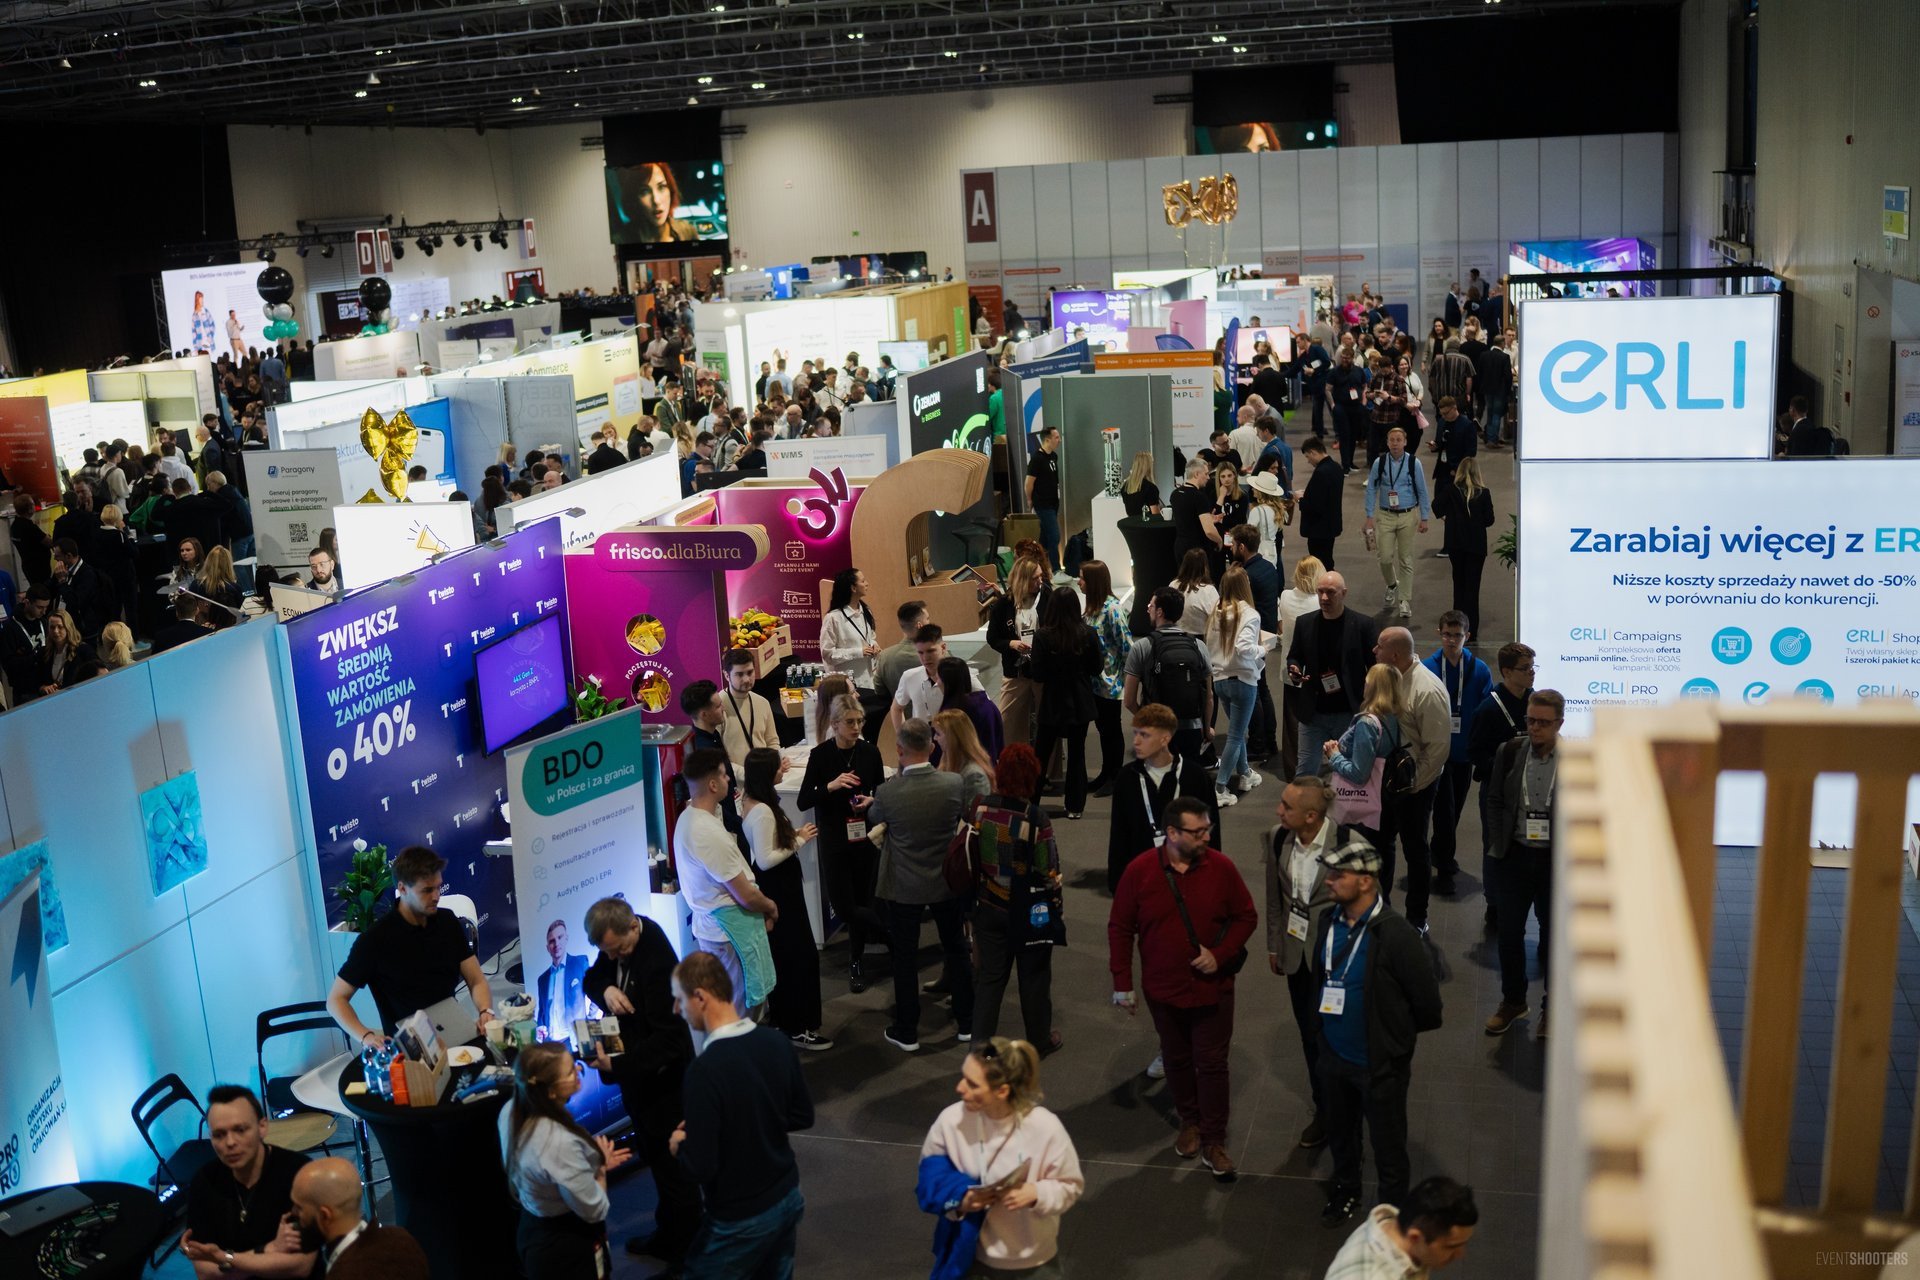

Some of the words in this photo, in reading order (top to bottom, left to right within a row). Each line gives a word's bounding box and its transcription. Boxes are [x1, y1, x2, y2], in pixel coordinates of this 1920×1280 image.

[971, 189, 991, 226] A
[360, 242, 372, 266] D
[382, 240, 391, 264] D
[280, 466, 315, 474] Paragony
[609, 542, 741, 560] frisco.dlaBiura
[1569, 525, 1711, 560] Zarabiaj
[1720, 525, 1837, 560] więcej
[1845, 533, 1864, 553] z
[499, 561, 507, 576] T
[507, 558, 522, 572] twisto
[1612, 572, 1661, 587] Niższe
[1665, 573, 1713, 590] koszty
[1718, 574, 1797, 590] sprzedaży
[1800, 576, 1849, 588] nawet
[1853, 574, 1874, 587] do
[1878, 574, 1917, 587] -50%
[428, 588, 438, 605] T
[438, 585, 455, 598] twisto
[536, 600, 544, 615] T
[544, 596, 558, 609] twisto
[1647, 595, 1661, 605] w
[1665, 592, 1756, 607] porównaniu
[1760, 592, 1781, 605] do
[1784, 592, 1880, 609] konkurencji.
[318, 605, 399, 660] ZWIĘKSZ
[471, 629, 480, 645] T
[480, 626, 496, 639] twisto
[1613, 631, 1682, 643] Campaigns
[336, 642, 393, 680] ŚREDNIĄ
[444, 642, 452, 657] T
[1560, 654, 1600, 663] kampanii
[1600, 655, 1629, 663] online.
[1630, 654, 1656, 662] Średni
[1598, 646, 1655, 654] Kompleksowa
[1656, 646, 1681, 654] oferta
[1847, 648, 1865, 656] Twój
[1866, 647, 1895, 656] własny
[1896, 647, 1918, 656] sklep
[1850, 656, 1880, 664] szeroki
[1882, 656, 1909, 666] pakiet
[625, 660, 662, 679] POCZĘSTUJ
[662, 666, 673, 679] SIĘ
[326, 663, 391, 707] WARTOŚĆ
[1632, 685, 1658, 695] PRO
[334, 676, 417, 728] ZAMÓWIENIA
[441, 702, 450, 718] T
[450, 697, 467, 712] twisto
[1591, 698, 1627, 706] dostawa
[327, 748, 348, 781] o
[353, 699, 417, 765] 40%
[542, 741, 604, 786] BDO
[411, 778, 420, 795] T
[421, 772, 438, 787] twisto
[546, 794, 555, 804] w
[557, 779, 586, 801] Polsce
[587, 776, 591, 789] i
[592, 776, 603, 787] za
[604, 763, 635, 785] granicą
[381, 796, 390, 812] T
[453, 813, 462, 829] T
[462, 806, 478, 820] twisto
[551, 823, 587, 842] Rejestracja
[592, 804, 635, 828] sprawozdania
[329, 825, 339, 842] T
[340, 818, 359, 833] twisto
[554, 850, 591, 870] Konsultacje
[592, 840, 616, 855] prawne
[556, 884, 579, 899] Audyty
[580, 876, 595, 888] BDO
[599, 869, 612, 880] EPR
[27, 1074, 62, 1126] ORGANIZACJA
[29, 1101, 53, 1140] ODZYSKU
[32, 1105, 61, 1154] OPAKOWAŃ
